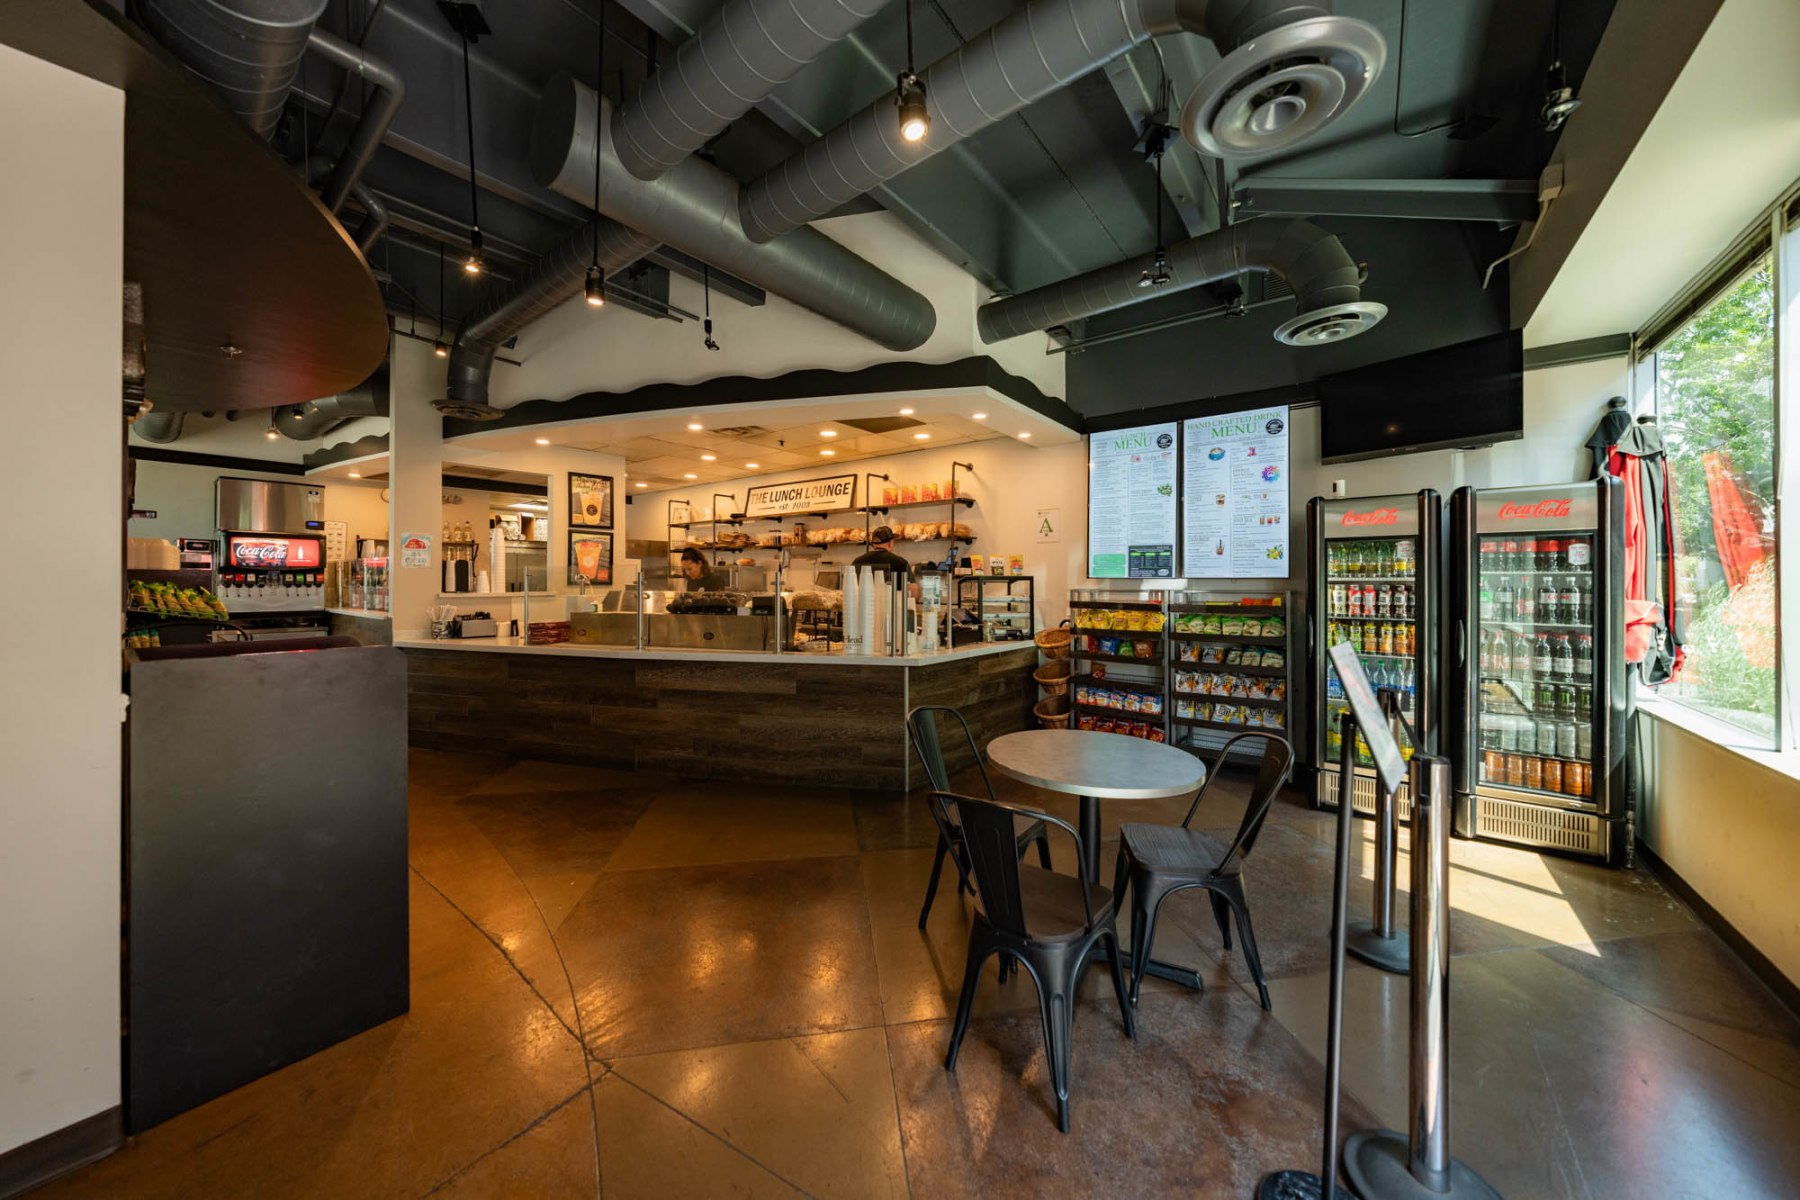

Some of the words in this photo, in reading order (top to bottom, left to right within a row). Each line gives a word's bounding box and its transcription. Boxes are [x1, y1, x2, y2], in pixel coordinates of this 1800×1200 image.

[1254, 411, 1282, 421] DRINK
[1212, 422, 1257, 438] MENU
[1115, 437, 1152, 451] MENU
[751, 492, 768, 504] THE
[769, 488, 803, 503] LUNCH
[805, 482, 850, 499] LOUNGE
[1341, 507, 1398, 527] Coca-Cola
[1498, 499, 1573, 520] Coca-Cola
[1040, 518, 1053, 533] A
[236, 545, 287, 559] Coca-Cola
